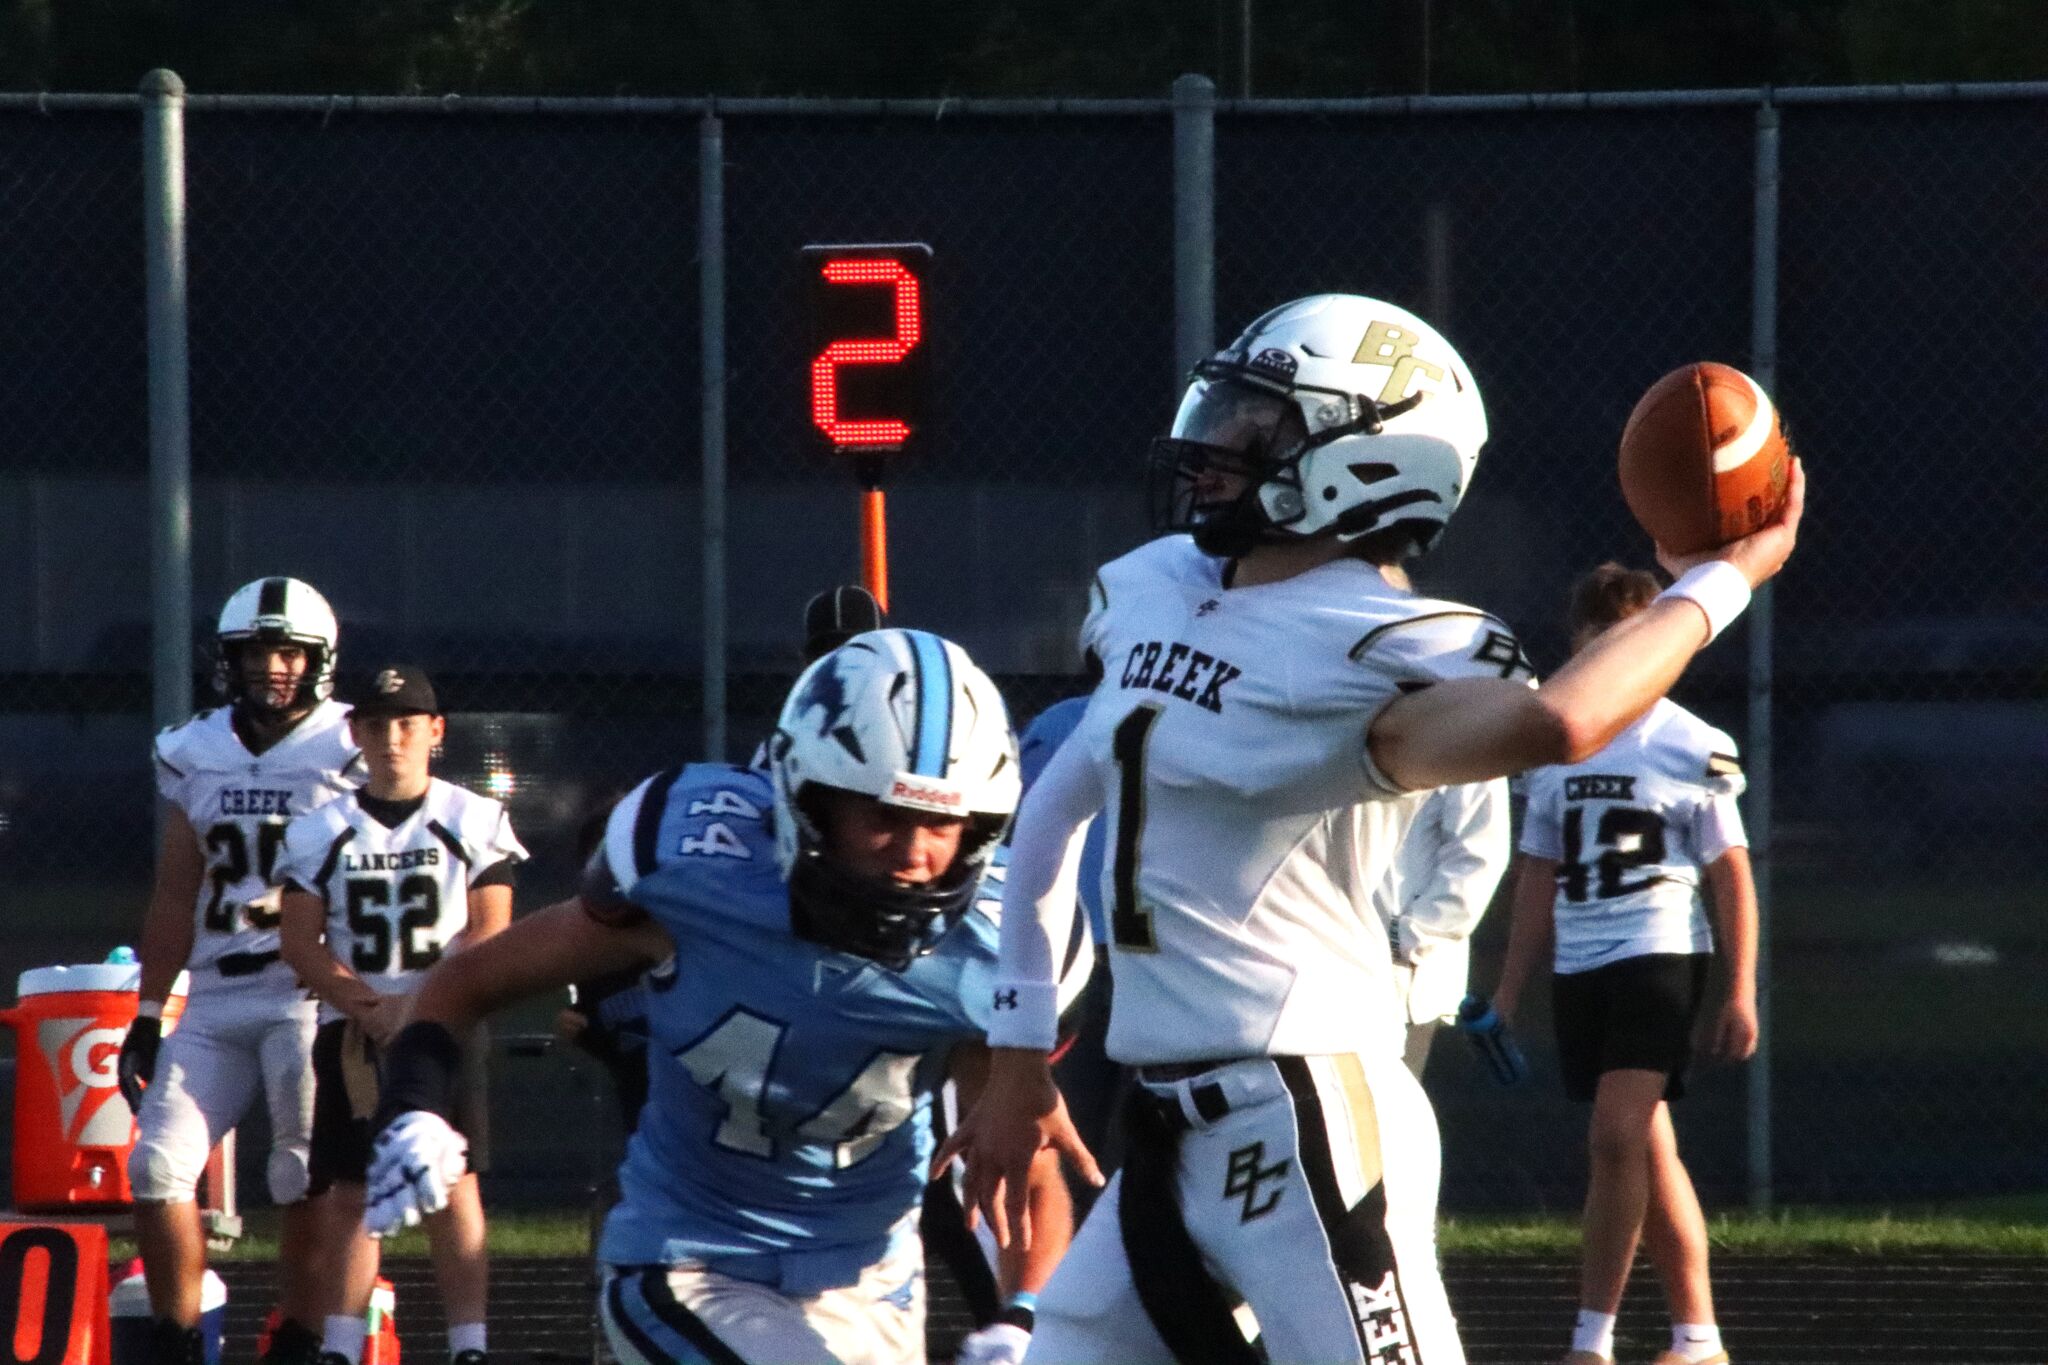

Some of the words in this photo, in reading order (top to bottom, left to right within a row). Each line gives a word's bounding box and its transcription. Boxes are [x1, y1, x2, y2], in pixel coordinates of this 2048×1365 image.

[812, 259, 920, 445] 2
[1121, 641, 1242, 715] CREEK
[220, 788, 293, 817] CREEK
[1113, 702, 1167, 953] 1
[345, 848, 439, 872] LANCERS
[1555, 806, 1668, 902] 12
[346, 875, 441, 973] 52
[71, 1028, 128, 1088] G
[1222, 1140, 1294, 1226] BC
